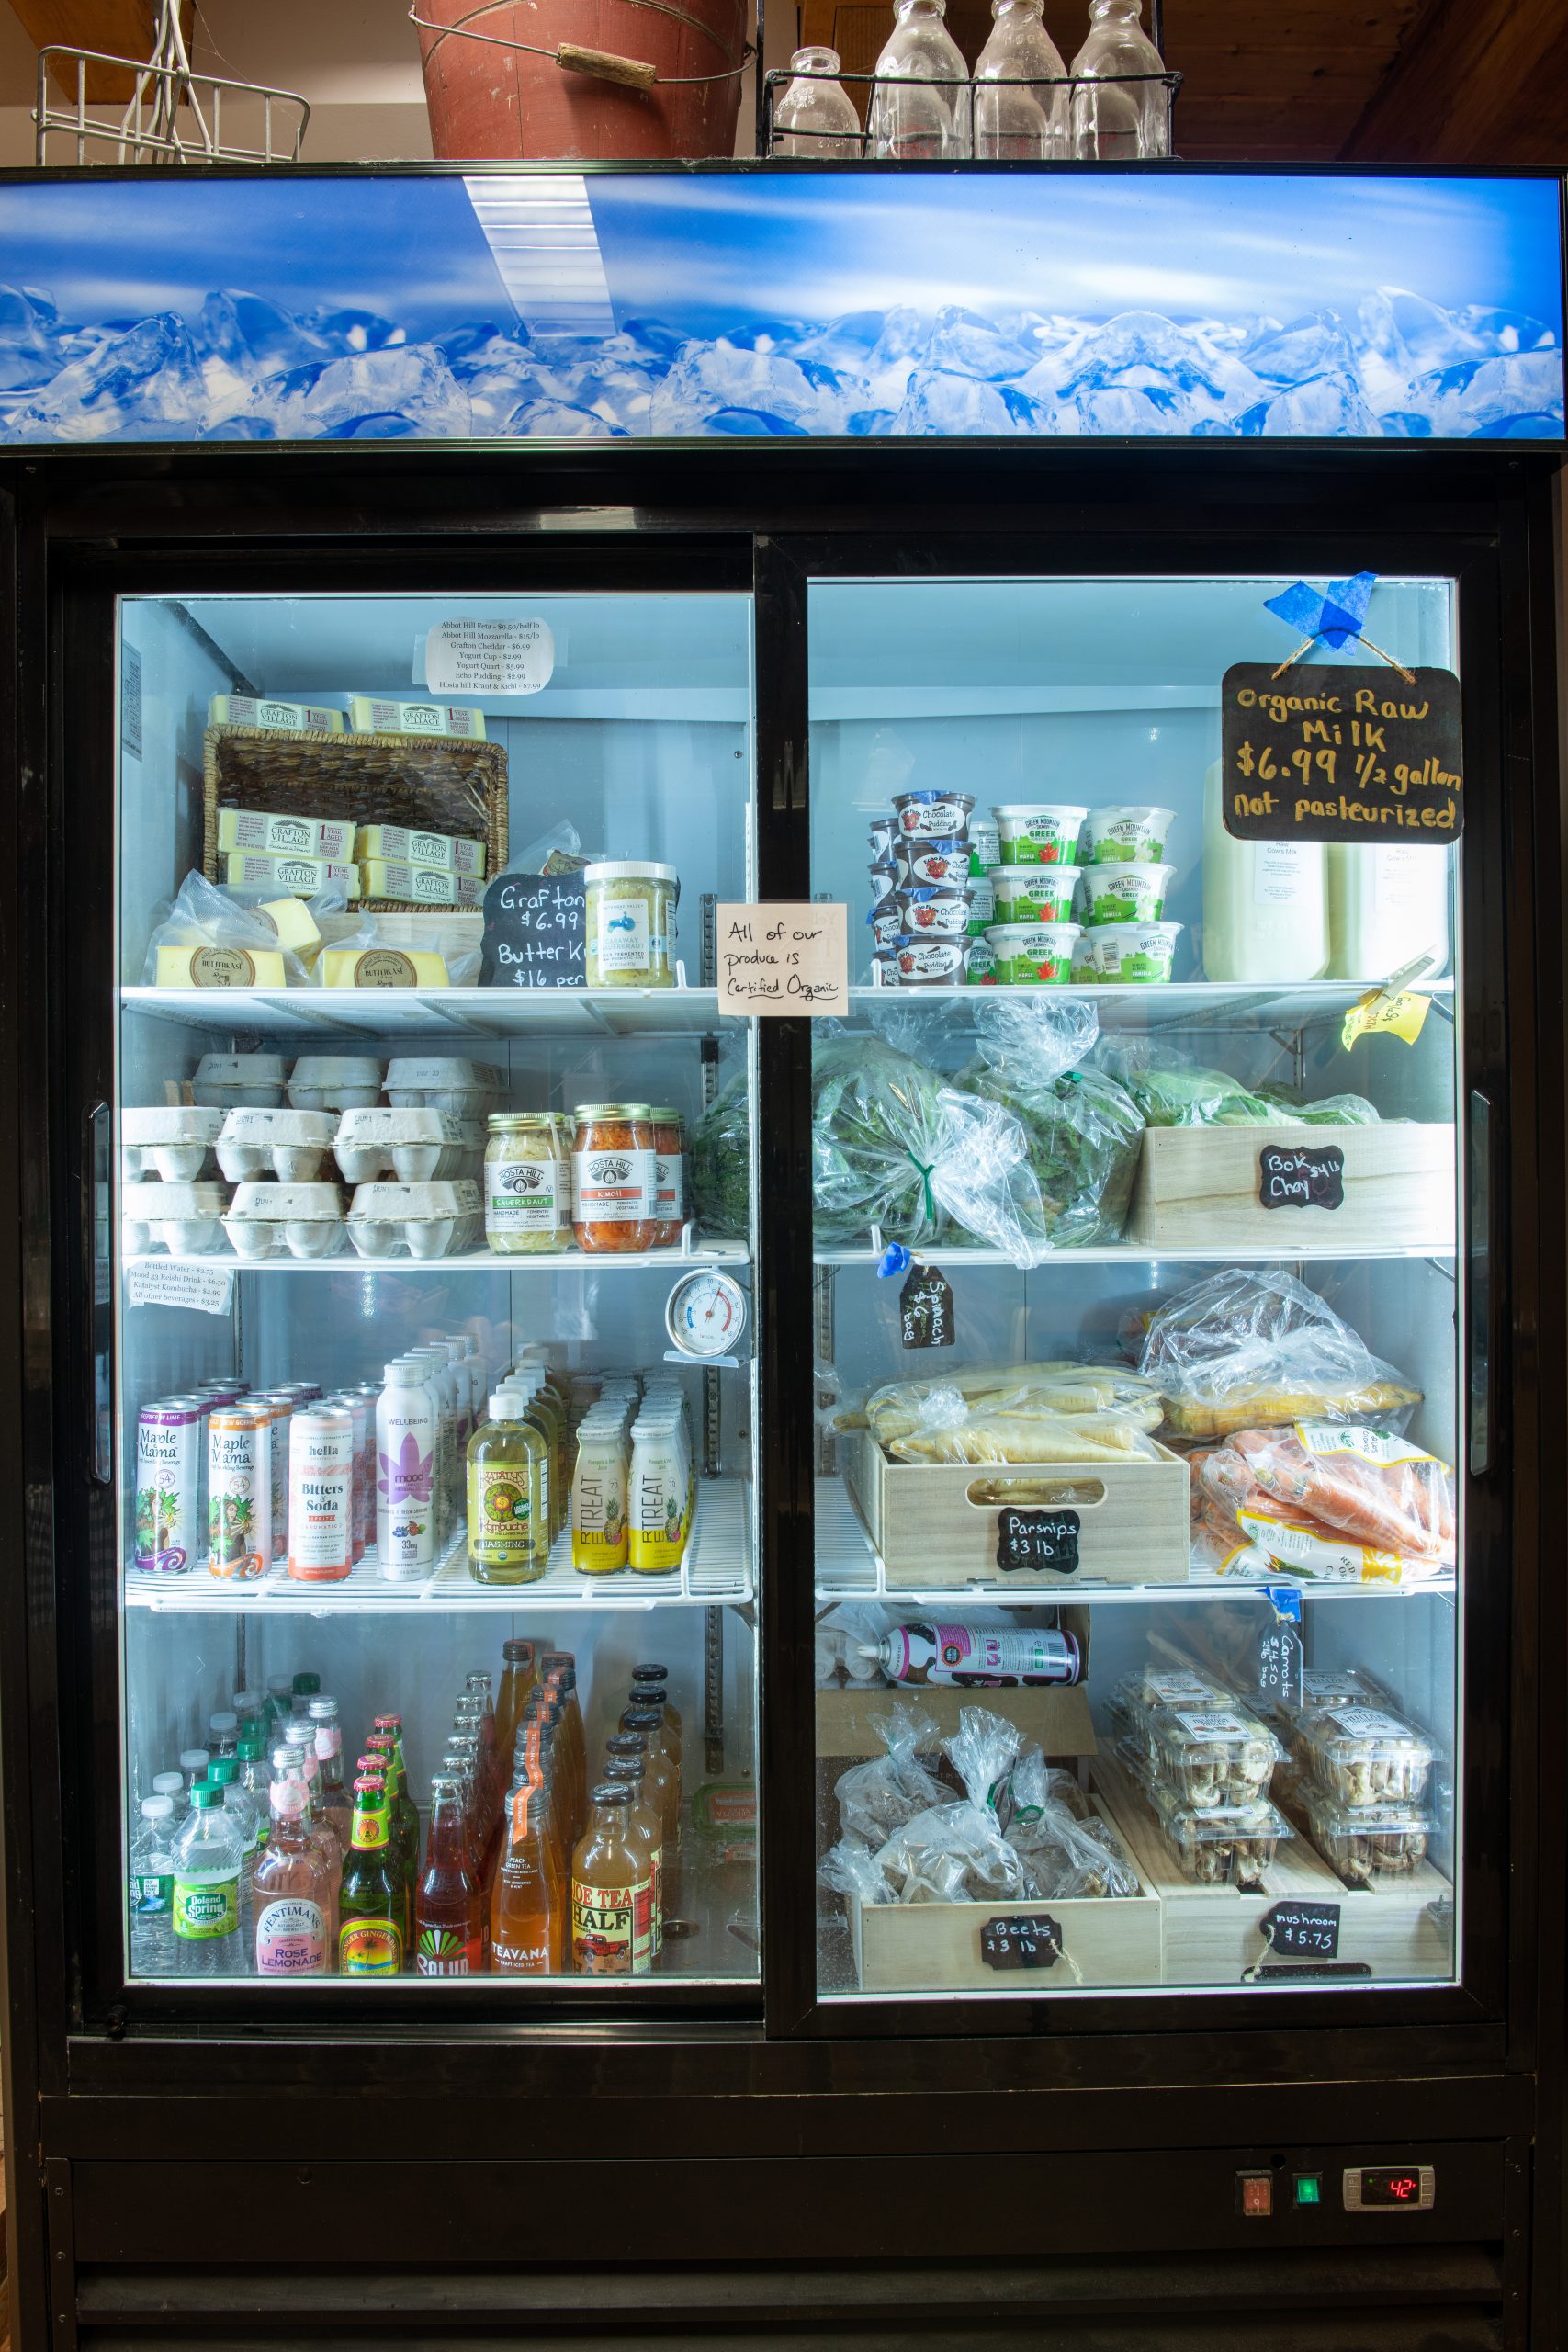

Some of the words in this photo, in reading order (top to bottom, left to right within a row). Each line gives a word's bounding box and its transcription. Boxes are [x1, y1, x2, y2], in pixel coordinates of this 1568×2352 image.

[518, 632, 540, 640] $15/lb
[459, 652, 482, 661] Yogurt
[483, 653, 497, 662] Cup
[457, 662, 479, 671] Yogurt
[480, 662, 500, 671] Quart
[473, 673, 502, 681] Pudding
[1237, 688, 1342, 723] Organic
[1355, 689, 1429, 720] Raw
[260, 708, 298, 720] GRAFTON
[261, 715, 297, 726] VILLAGE
[403, 712, 440, 720] GRAFTON
[404, 718, 440, 726] VILLAGE
[1303, 719, 1387, 752] Milk
[1236, 741, 1337, 786] $6.99
[1389, 757, 1461, 796] gallon
[922, 809, 956, 818] Chocolate
[1234, 790, 1280, 817] not
[1295, 795, 1456, 829] pasteurized
[271, 828, 310, 838] GRAFTON
[1107, 825, 1124, 836] GREEN
[271, 834, 310, 845] VILLAGE
[412, 841, 446, 852] GRAFTON
[412, 847, 446, 858] VILLAGE
[278, 868, 317, 877] GRAFTON
[278, 875, 316, 884] VILLAGE
[415, 877, 449, 888] GRAFTON
[1108, 881, 1124, 891] GREEN
[416, 884, 449, 895] VILLAGE
[500, 885, 585, 910] Grafton
[521, 911, 579, 930] $6.99
[728, 922, 753, 943] All
[766, 922, 786, 941] of
[793, 930, 823, 941] our
[786, 952, 800, 965] is
[919, 950, 952, 960] Chocolate
[513, 969, 547, 987] $16
[556, 975, 585, 988] per
[727, 978, 779, 996] Certified
[787, 974, 839, 1001] Organic
[589, 1159, 614, 1172] HOSTA
[615, 1159, 632, 1171] HILL
[1268, 1155, 1311, 1171] Bok
[499, 1169, 525, 1182] HOSTA
[526, 1169, 542, 1182] HILL
[1270, 1175, 1310, 1200] Choy
[496, 1197, 549, 1207] SAUERKRAUT
[144, 1261, 168, 1271] Bottled
[170, 1263, 190, 1272] Water
[196, 1268, 214, 1276] $2.75
[130, 1271, 150, 1279] Mood
[161, 1274, 181, 1283] Reishi
[183, 1275, 201, 1283] Drink
[133, 1282, 160, 1291] Katalyst
[162, 1283, 197, 1294] Kombucha
[202, 1288, 221, 1297] $4.99
[143, 1293, 162, 1301] other
[164, 1294, 196, 1305] beverages
[200, 1298, 220, 1306] $3.25
[927, 1281, 946, 1346] Spinach
[903, 1312, 915, 1341] bag
[389, 1418, 429, 1426] WELLBEING
[141, 1429, 176, 1444] Maple
[212, 1434, 251, 1450] Maple
[140, 1442, 176, 1458] Mama
[211, 1449, 251, 1464] Mama
[309, 1445, 339, 1456] hella
[158, 1473, 172, 1485] 54
[395, 1469, 424, 1482] mood
[233, 1479, 246, 1490] 54
[302, 1483, 344, 1495] Bitters
[306, 1499, 339, 1511] Soda
[1010, 1516, 1077, 1541] Parsnips
[1010, 1538, 1030, 1554] $3
[1036, 1540, 1054, 1555] lb
[191, 1894, 220, 1905] Poland
[573, 1881, 593, 1906] JOE
[597, 1888, 633, 1908] TEA
[188, 1903, 224, 1918] Spring
[264, 1906, 321, 1933] FENTIMANS
[573, 1904, 631, 1931] HALF
[1276, 1912, 1337, 1927] mushroom
[996, 1919, 1051, 1937] Beets
[360, 1930, 390, 1942] GINGER
[1285, 1928, 1332, 1950] $5.75
[491, 1940, 548, 1961] TEAVANA
[1020, 1940, 1037, 1952] lb
[261, 1951, 322, 1968] LEMONADE
[276, 1948, 308, 1958] ROSE
